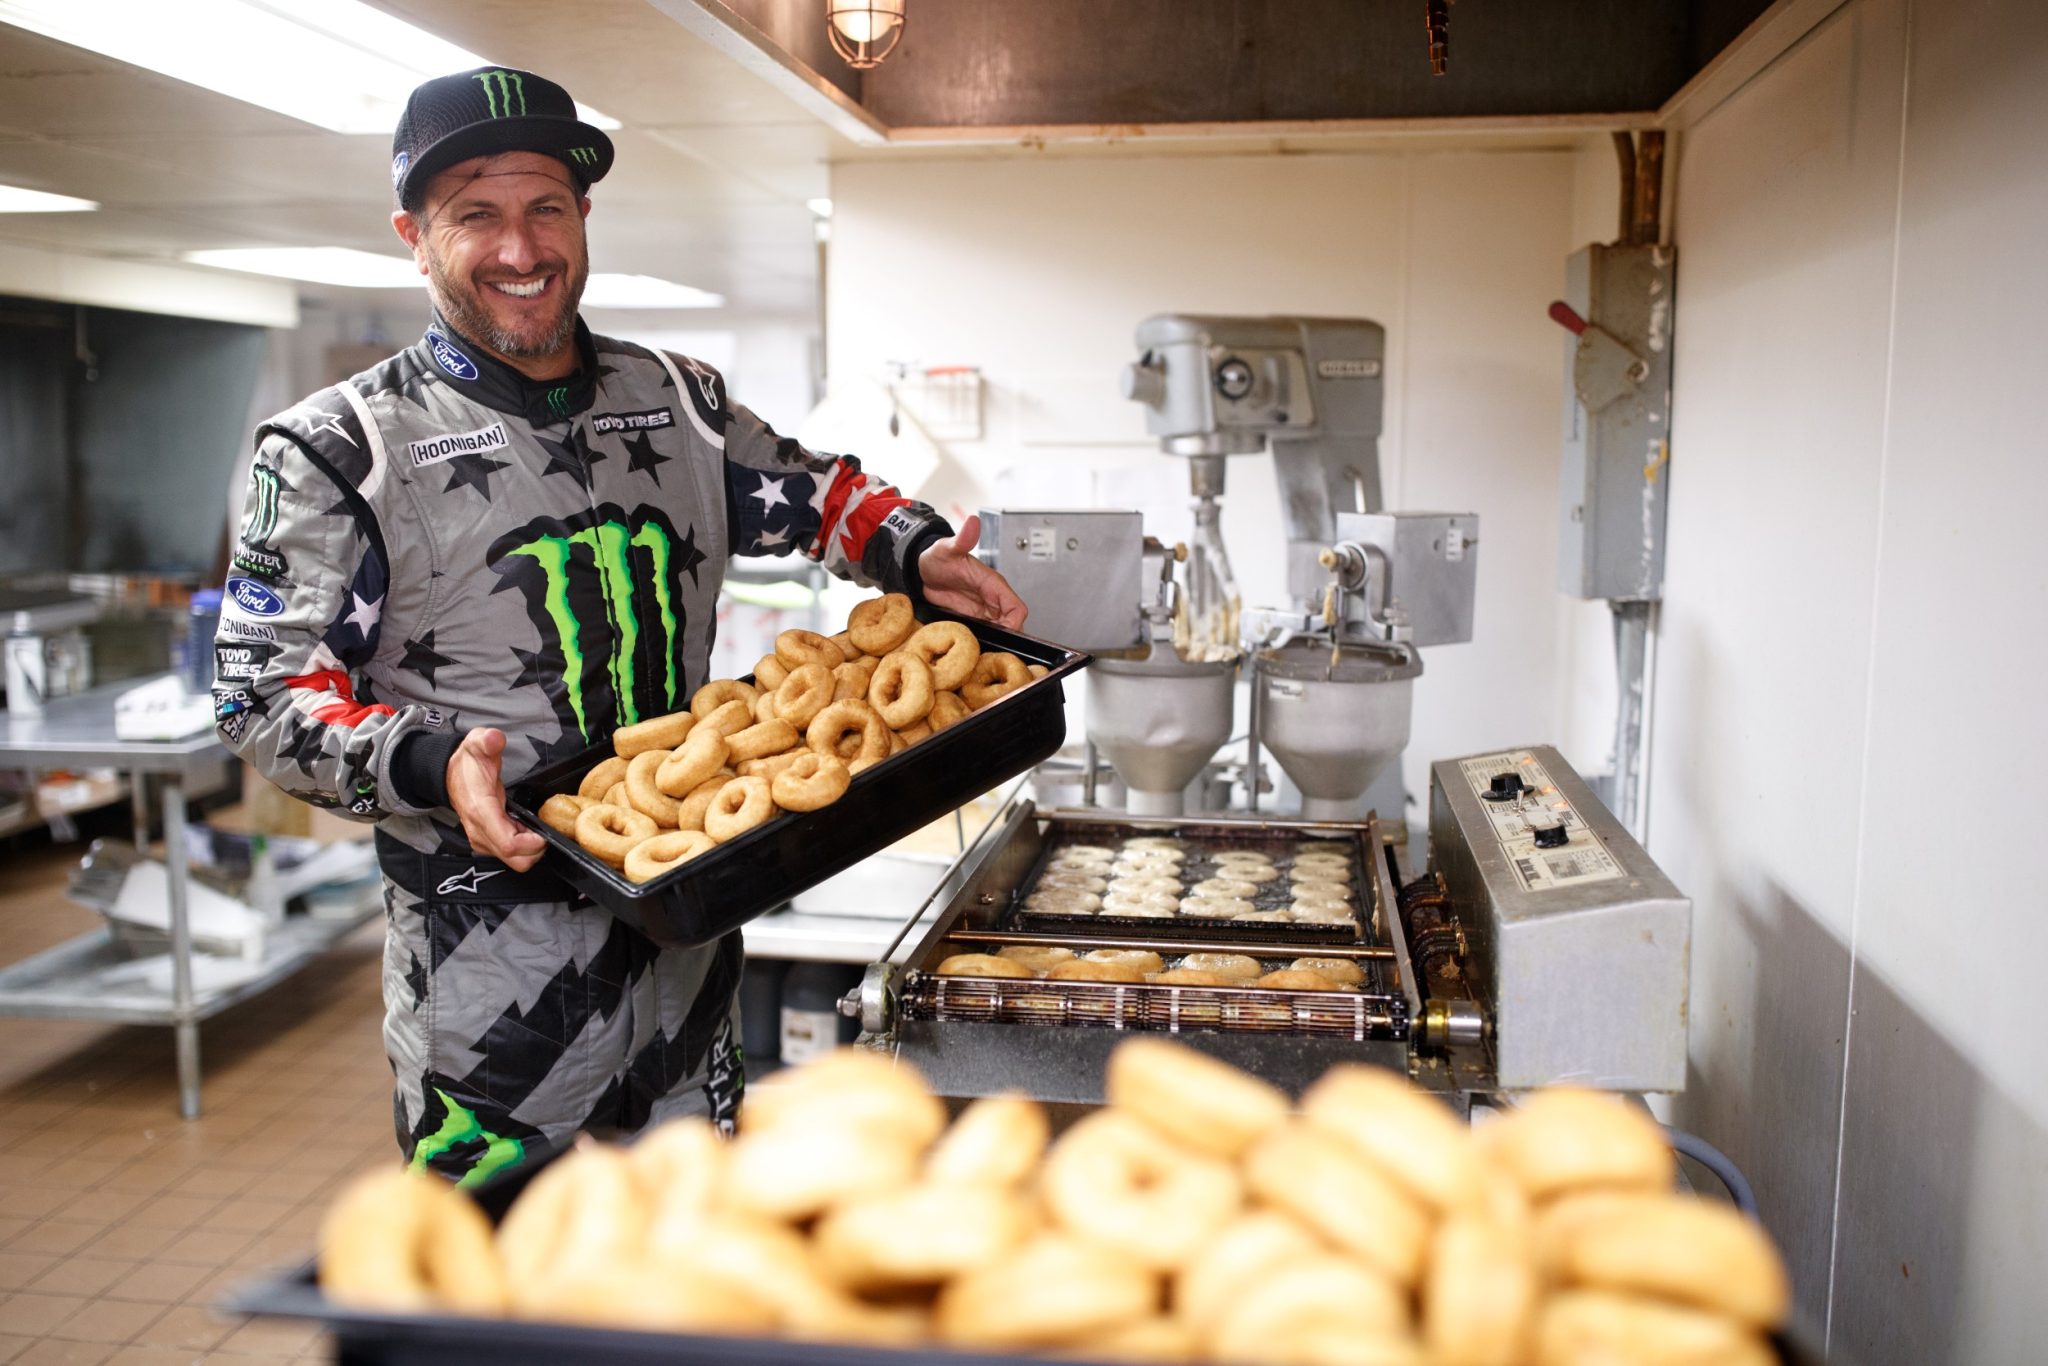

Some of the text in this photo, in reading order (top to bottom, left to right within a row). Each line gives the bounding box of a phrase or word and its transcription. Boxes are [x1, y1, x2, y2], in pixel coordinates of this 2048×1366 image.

[435, 341, 467, 374] Ford
[593, 411, 670, 432] TOYO TIRES
[410, 425, 505, 465] [HOONIGAN]
[235, 581, 270, 612] Ford
[217, 648, 252, 663] TOYO
[223, 662, 263, 679] TIRES
